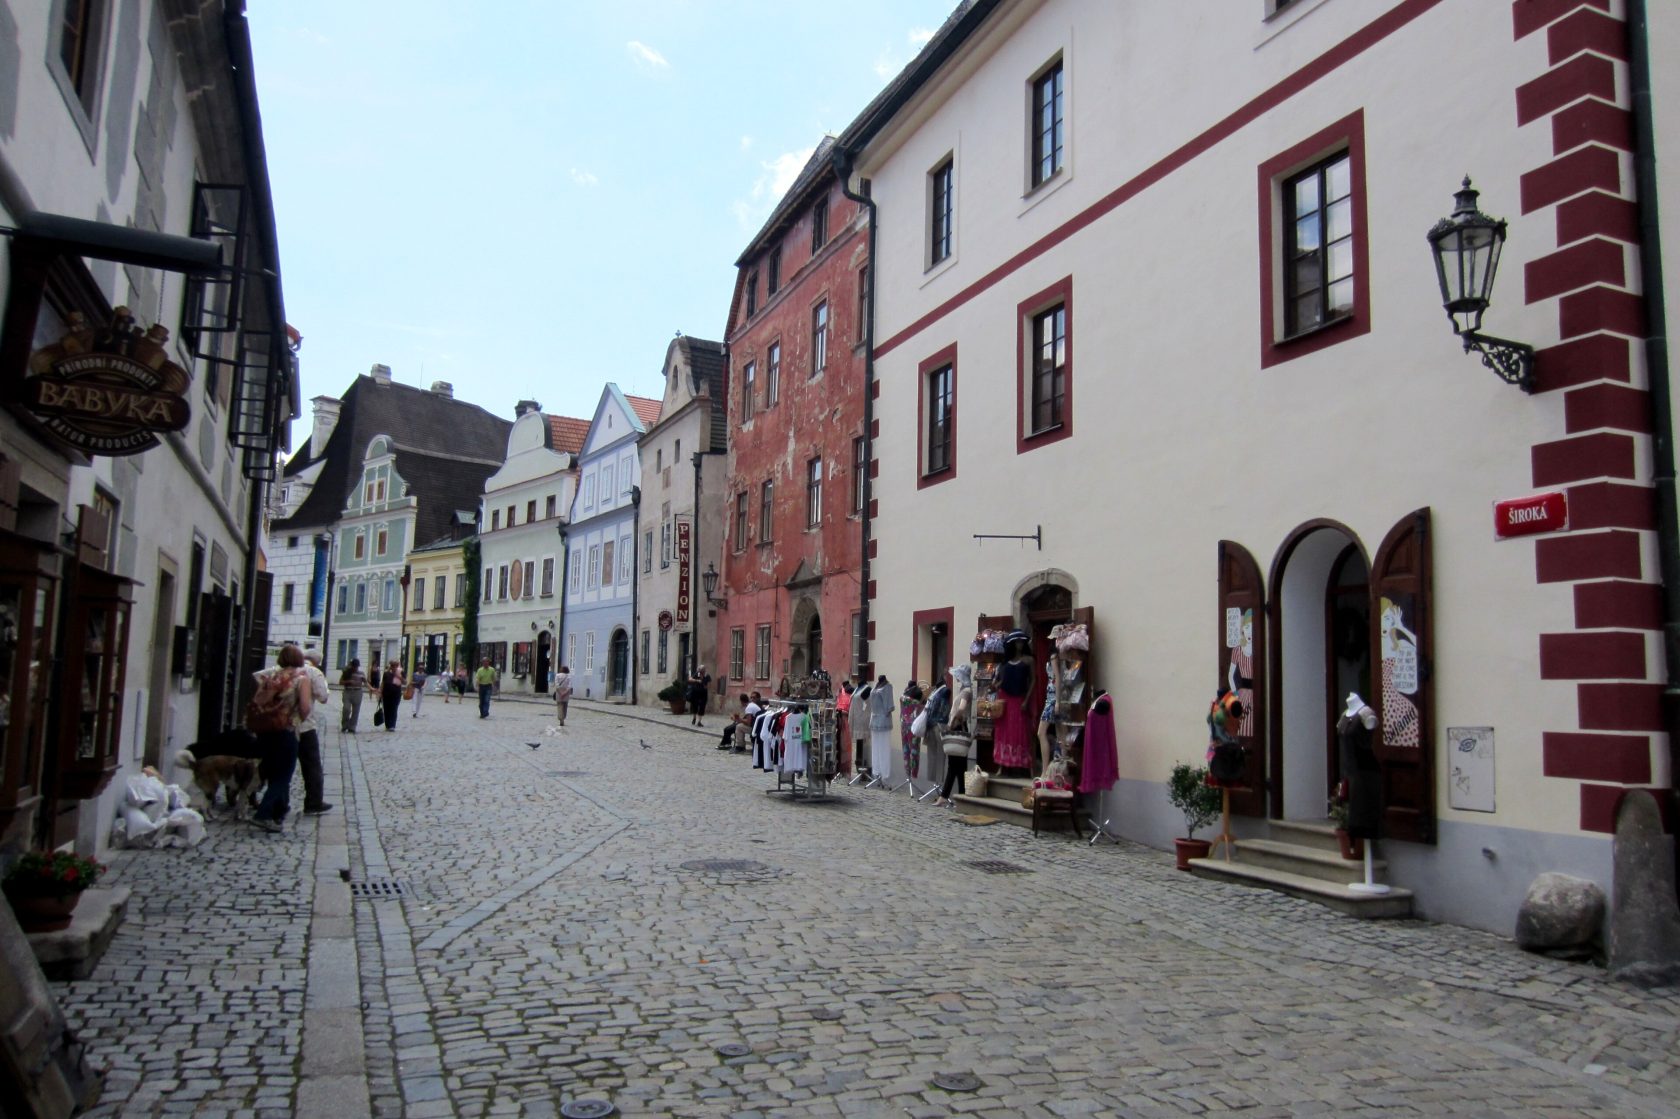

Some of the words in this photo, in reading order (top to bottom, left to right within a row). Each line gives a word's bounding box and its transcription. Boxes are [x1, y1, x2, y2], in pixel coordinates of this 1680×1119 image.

[110, 359, 159, 387] PRODUKTY
[38, 381, 173, 422] BABYKA
[89, 430, 151, 449] PRODUCTS
[1508, 501, 1548, 525] ŠIROKÁ
[678, 525, 689, 620] PENZION
